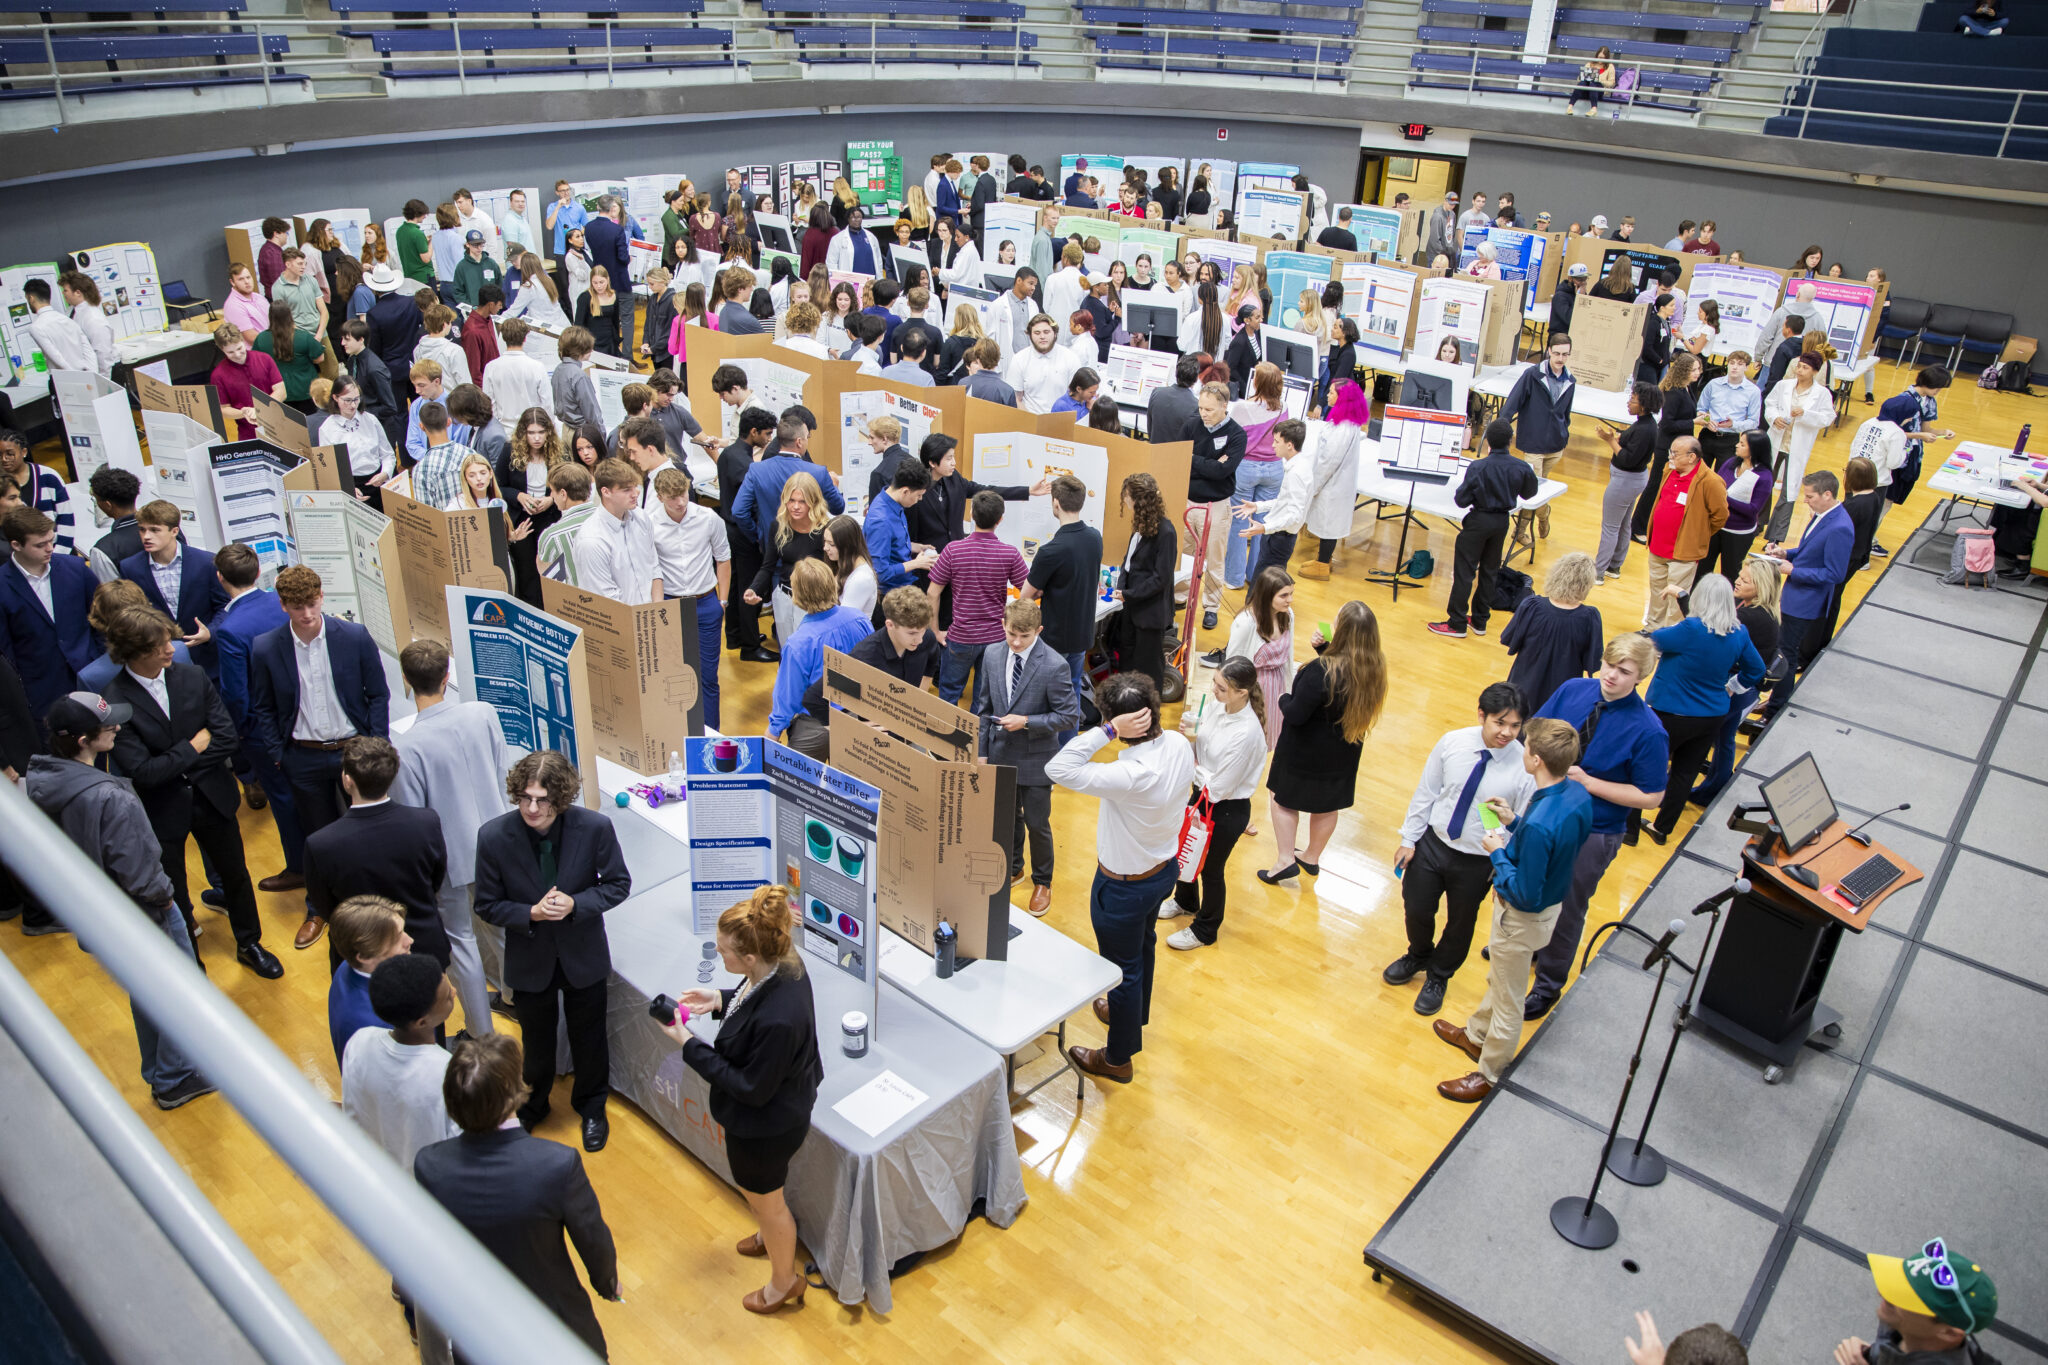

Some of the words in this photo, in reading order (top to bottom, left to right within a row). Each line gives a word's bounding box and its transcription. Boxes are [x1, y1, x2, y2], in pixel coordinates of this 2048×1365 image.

[1408, 124, 1424, 136] EXIT
[885, 392, 895, 405] The
[900, 397, 918, 413] Better
[216, 453, 232, 461] HHO
[468, 515, 478, 531] Pacon
[579, 594, 592, 603] Pacon
[484, 614, 506, 624] CAPS
[577, 604, 599, 615] Presentation
[658, 608, 669, 626] Pacon
[546, 626, 569, 644] BOTTLE
[889, 683, 906, 693] Pacon
[869, 684, 884, 696] Tri-Fold
[885, 693, 912, 710] Presentation
[913, 707, 926, 718] Board
[861, 696, 877, 708] Panneau
[906, 719, 916, 727] trois
[894, 707, 926, 726] presentaciones
[873, 737, 890, 748] Pacon
[854, 738, 869, 749] Tri-Fold
[870, 747, 896, 765] Presentation
[897, 761, 910, 772] Board
[774, 750, 812, 774] Portable
[814, 768, 842, 788] Water
[844, 782, 870, 801] Filter
[845, 748, 862, 761] Panneau
[863, 758, 885, 774] d'affichage
[890, 773, 900, 782] trois
[901, 778, 919, 792] battants
[879, 760, 911, 780] presentaciones
[968, 773, 979, 793] Pacon
[772, 768, 784, 779] Zach
[800, 782, 816, 794] Gauge
[817, 790, 831, 802] Repa,
[833, 796, 850, 808] Maeve
[851, 806, 872, 820] Conboy
[797, 798, 812, 810] Design
[812, 806, 845, 825] Demonstration
[655, 1075, 679, 1109] stl
[684, 1098, 725, 1144] CAP
[1907, 1258, 1931, 1276] A's
